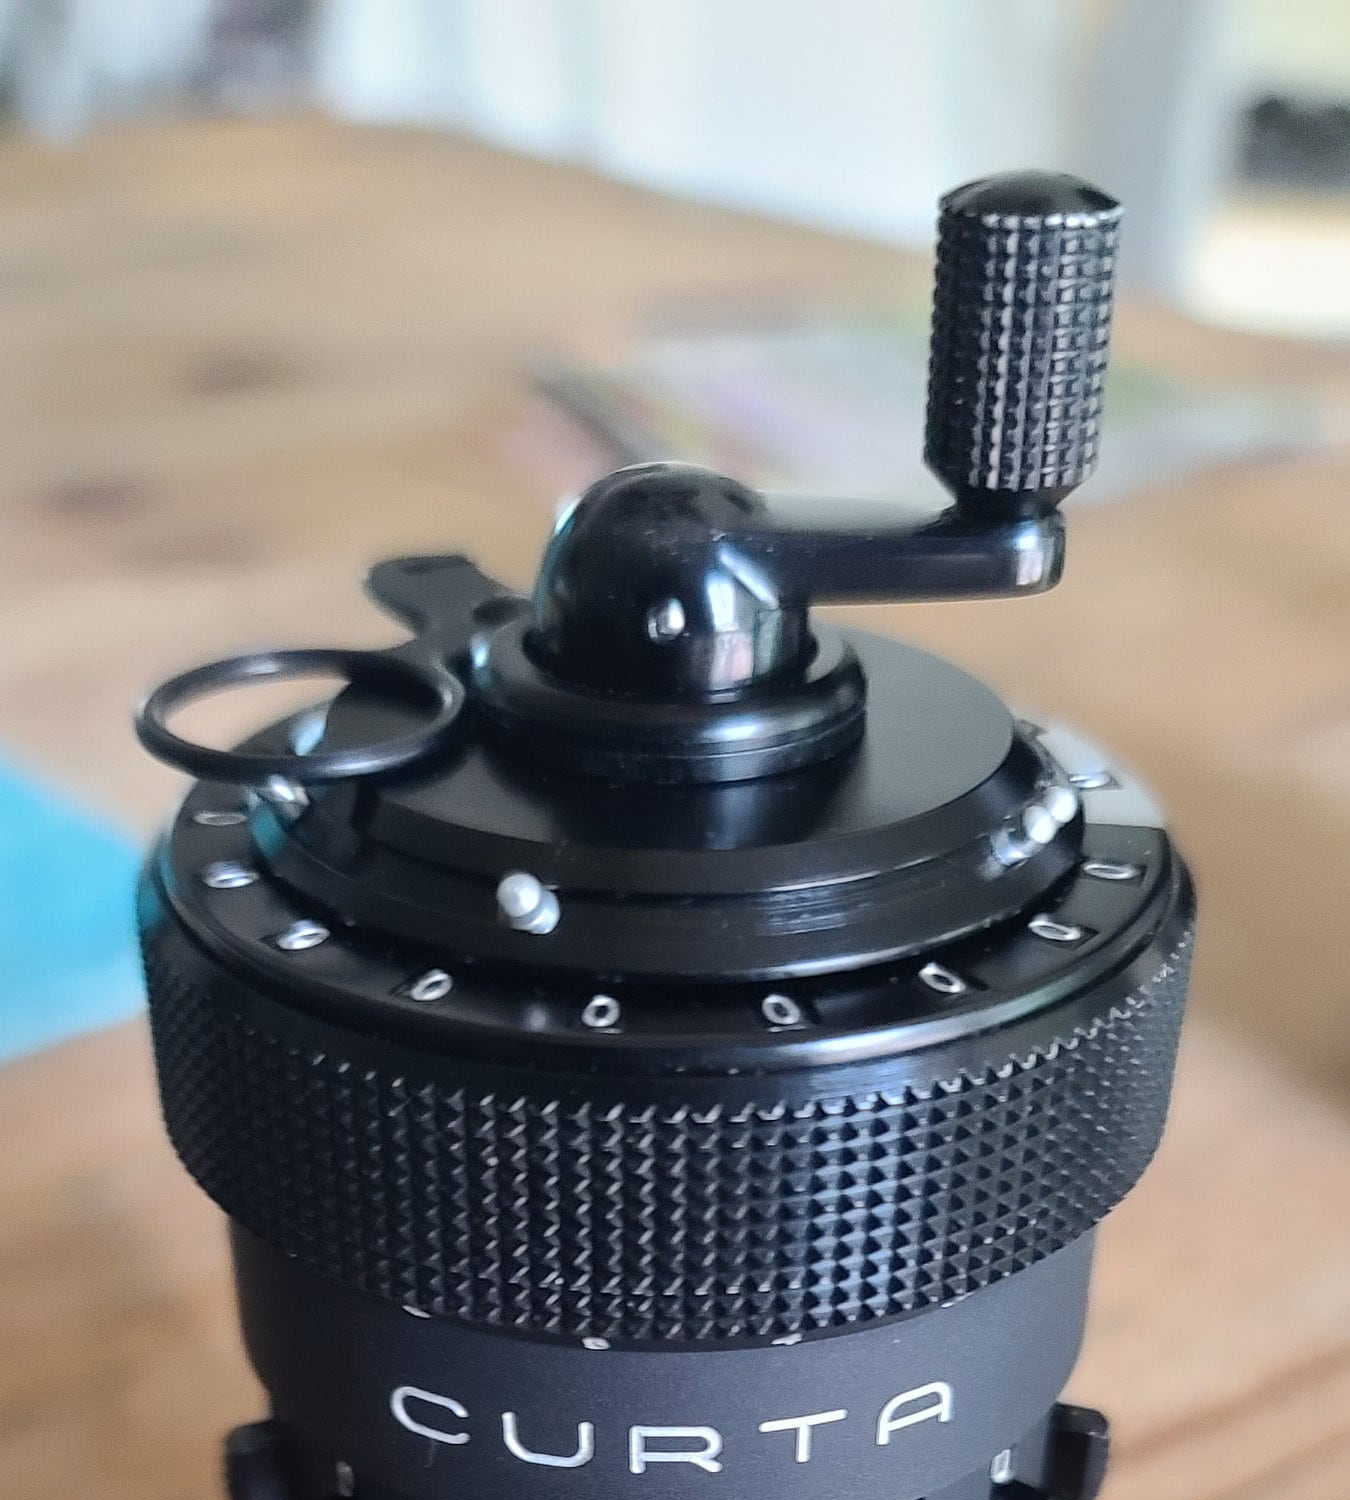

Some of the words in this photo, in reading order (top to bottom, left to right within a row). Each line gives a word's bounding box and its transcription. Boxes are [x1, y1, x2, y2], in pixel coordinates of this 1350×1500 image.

[582, 994, 620, 1028] 0
[762, 994, 801, 1026] 0
[390, 1381, 953, 1474] CURTA
